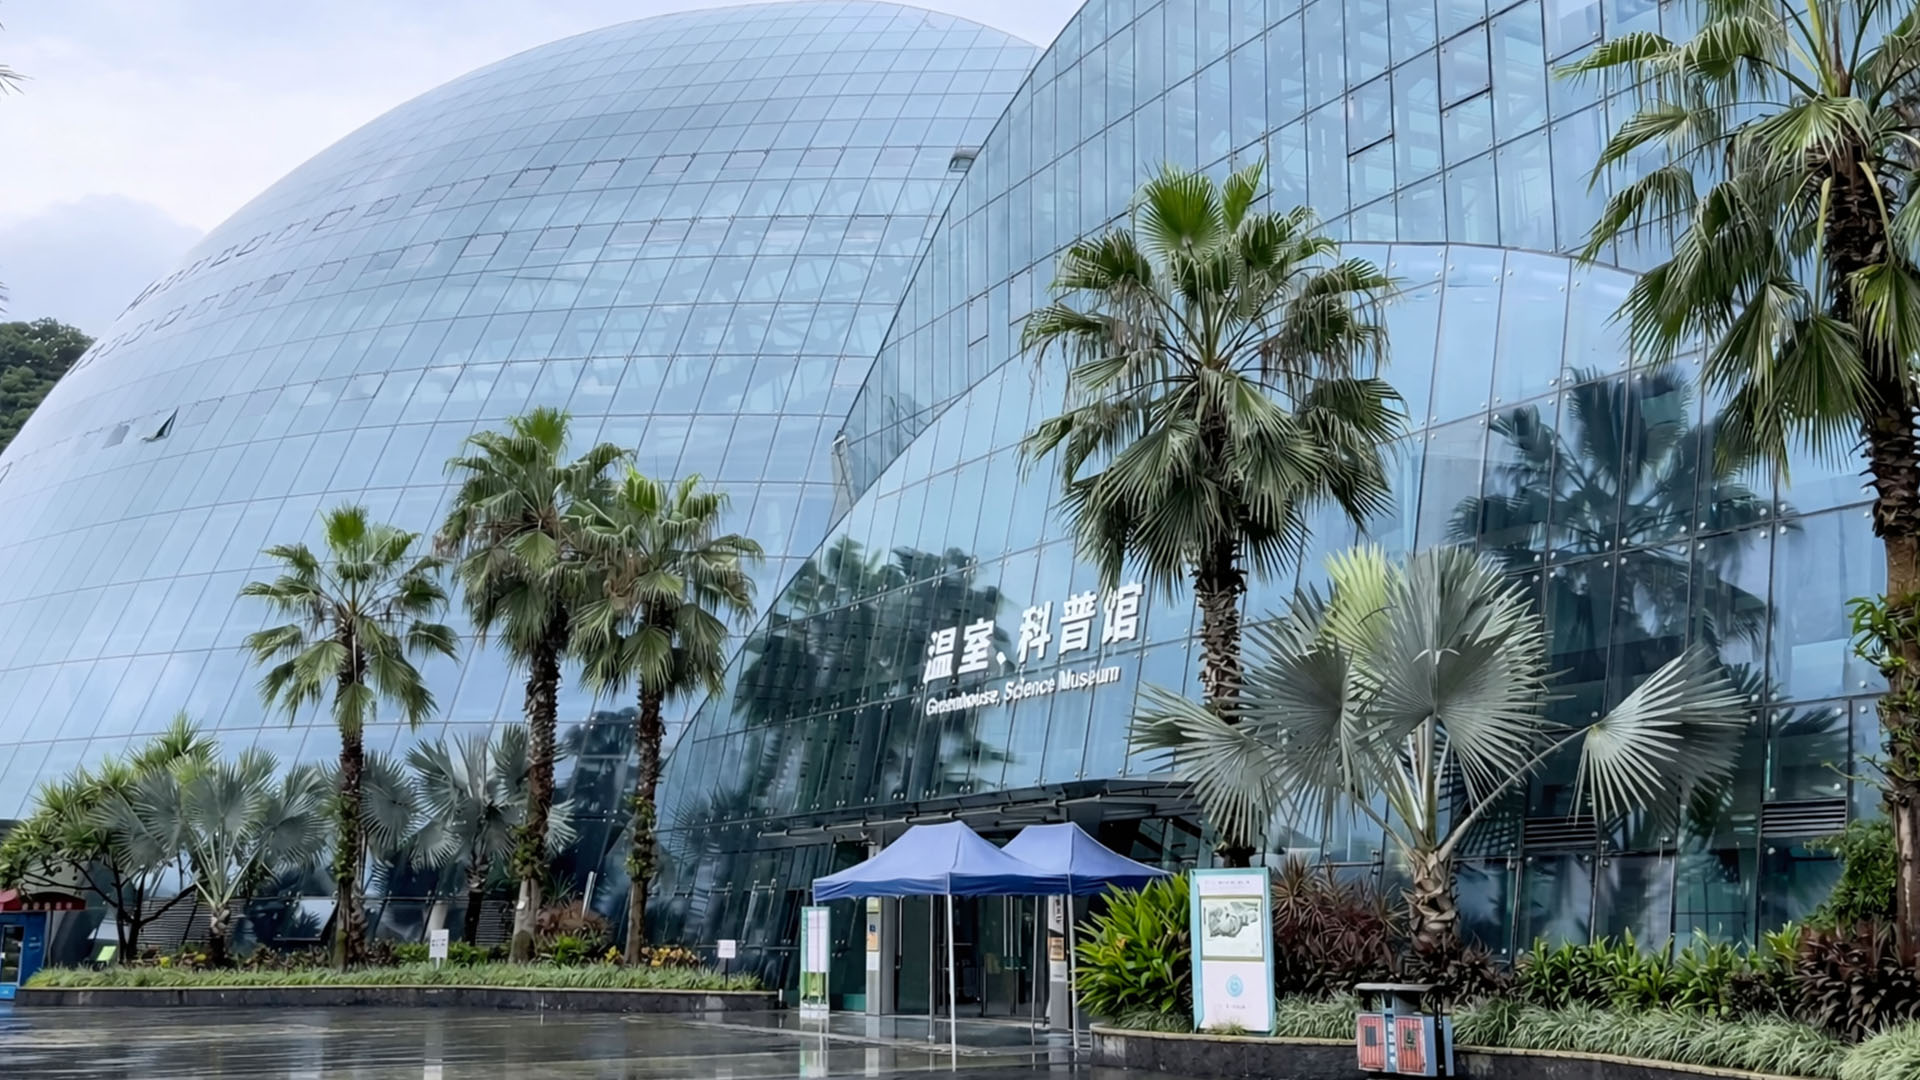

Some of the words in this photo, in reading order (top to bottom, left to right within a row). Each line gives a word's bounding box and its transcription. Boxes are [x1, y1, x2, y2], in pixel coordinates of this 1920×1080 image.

[923, 582, 1144, 684] 温室、科普馆
[1004, 678, 1055, 702] Science
[1058, 666, 1120, 692] Museum
